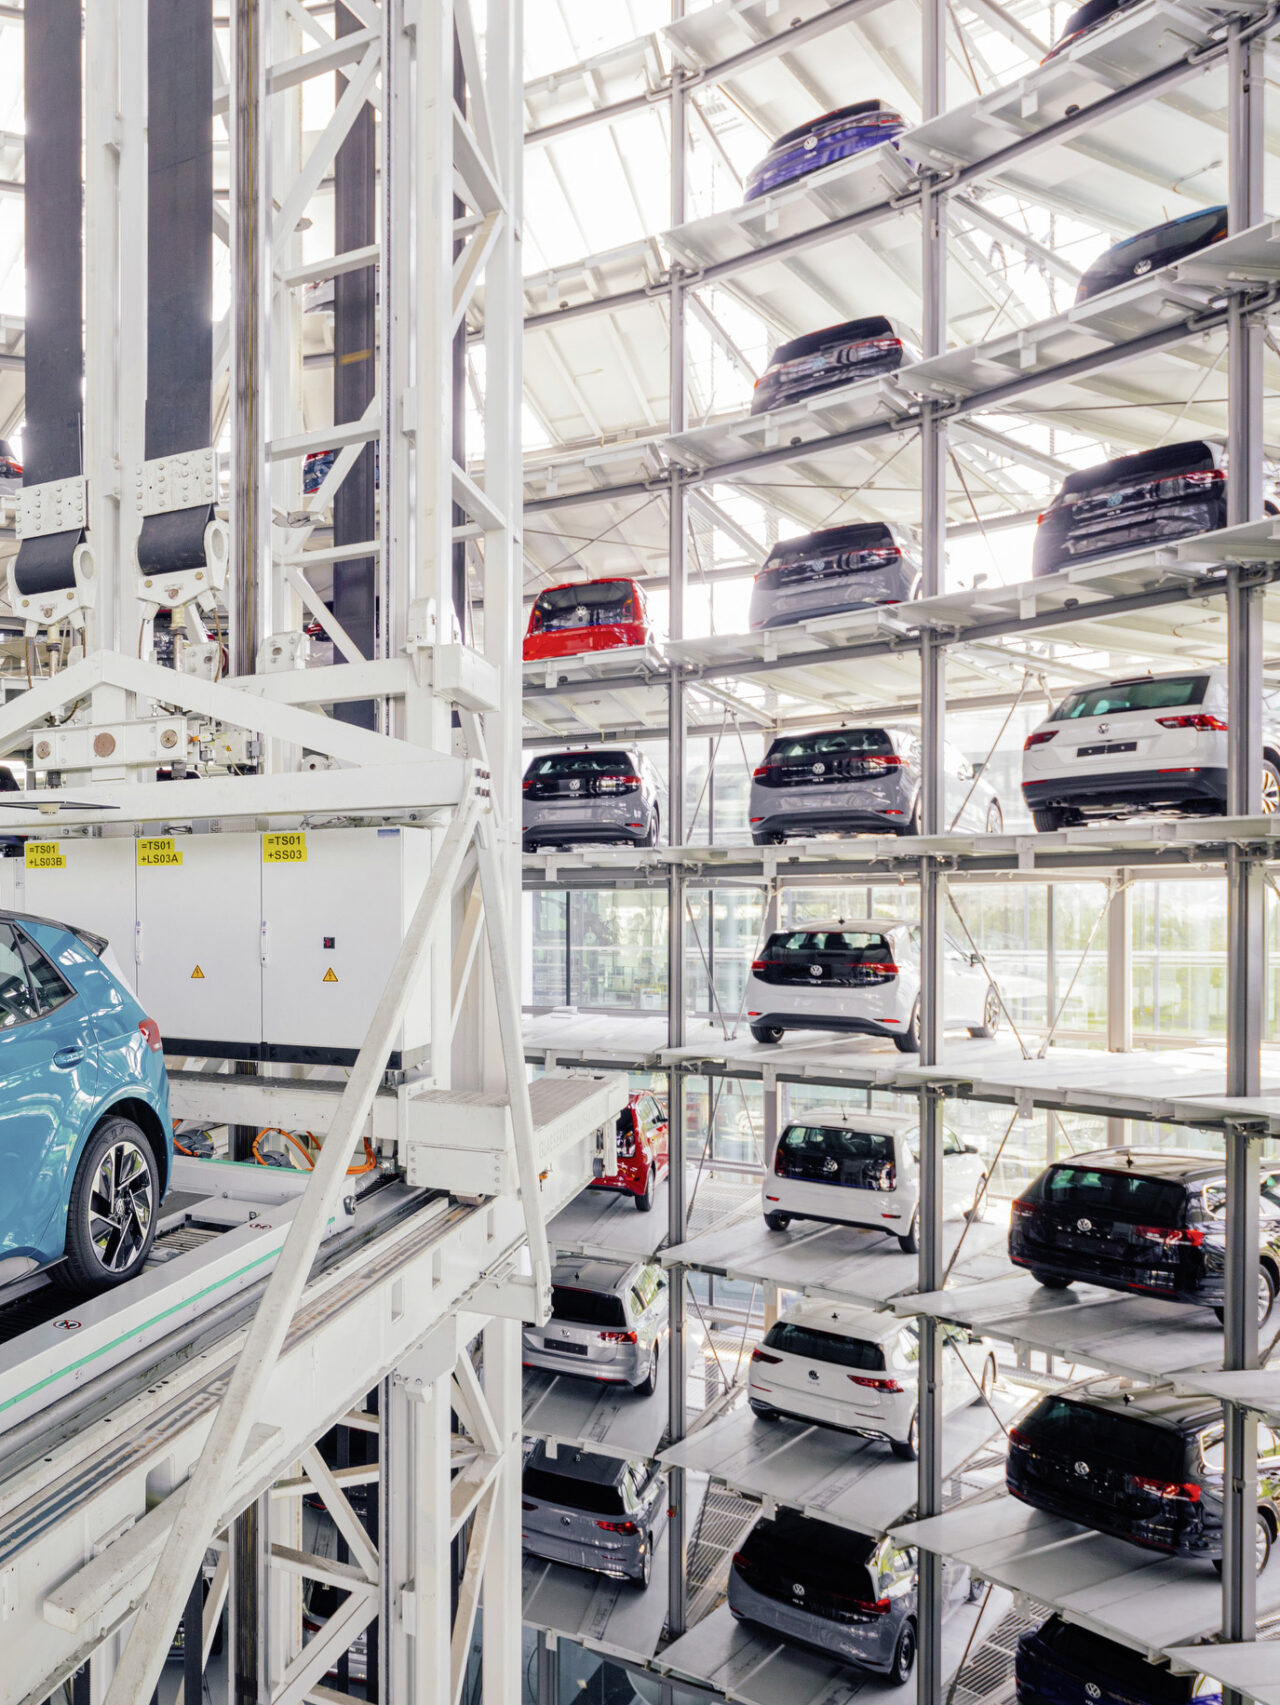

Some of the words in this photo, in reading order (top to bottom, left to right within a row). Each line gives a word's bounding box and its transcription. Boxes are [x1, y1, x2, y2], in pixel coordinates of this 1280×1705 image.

[268, 836, 301, 845] =TS01
[29, 845, 56, 854] =TS01
[141, 841, 171, 850] =TS01
[141, 854, 179, 864] +LS03A
[268, 850, 302, 860] +SS03
[29, 857, 62, 867] +LS03B
